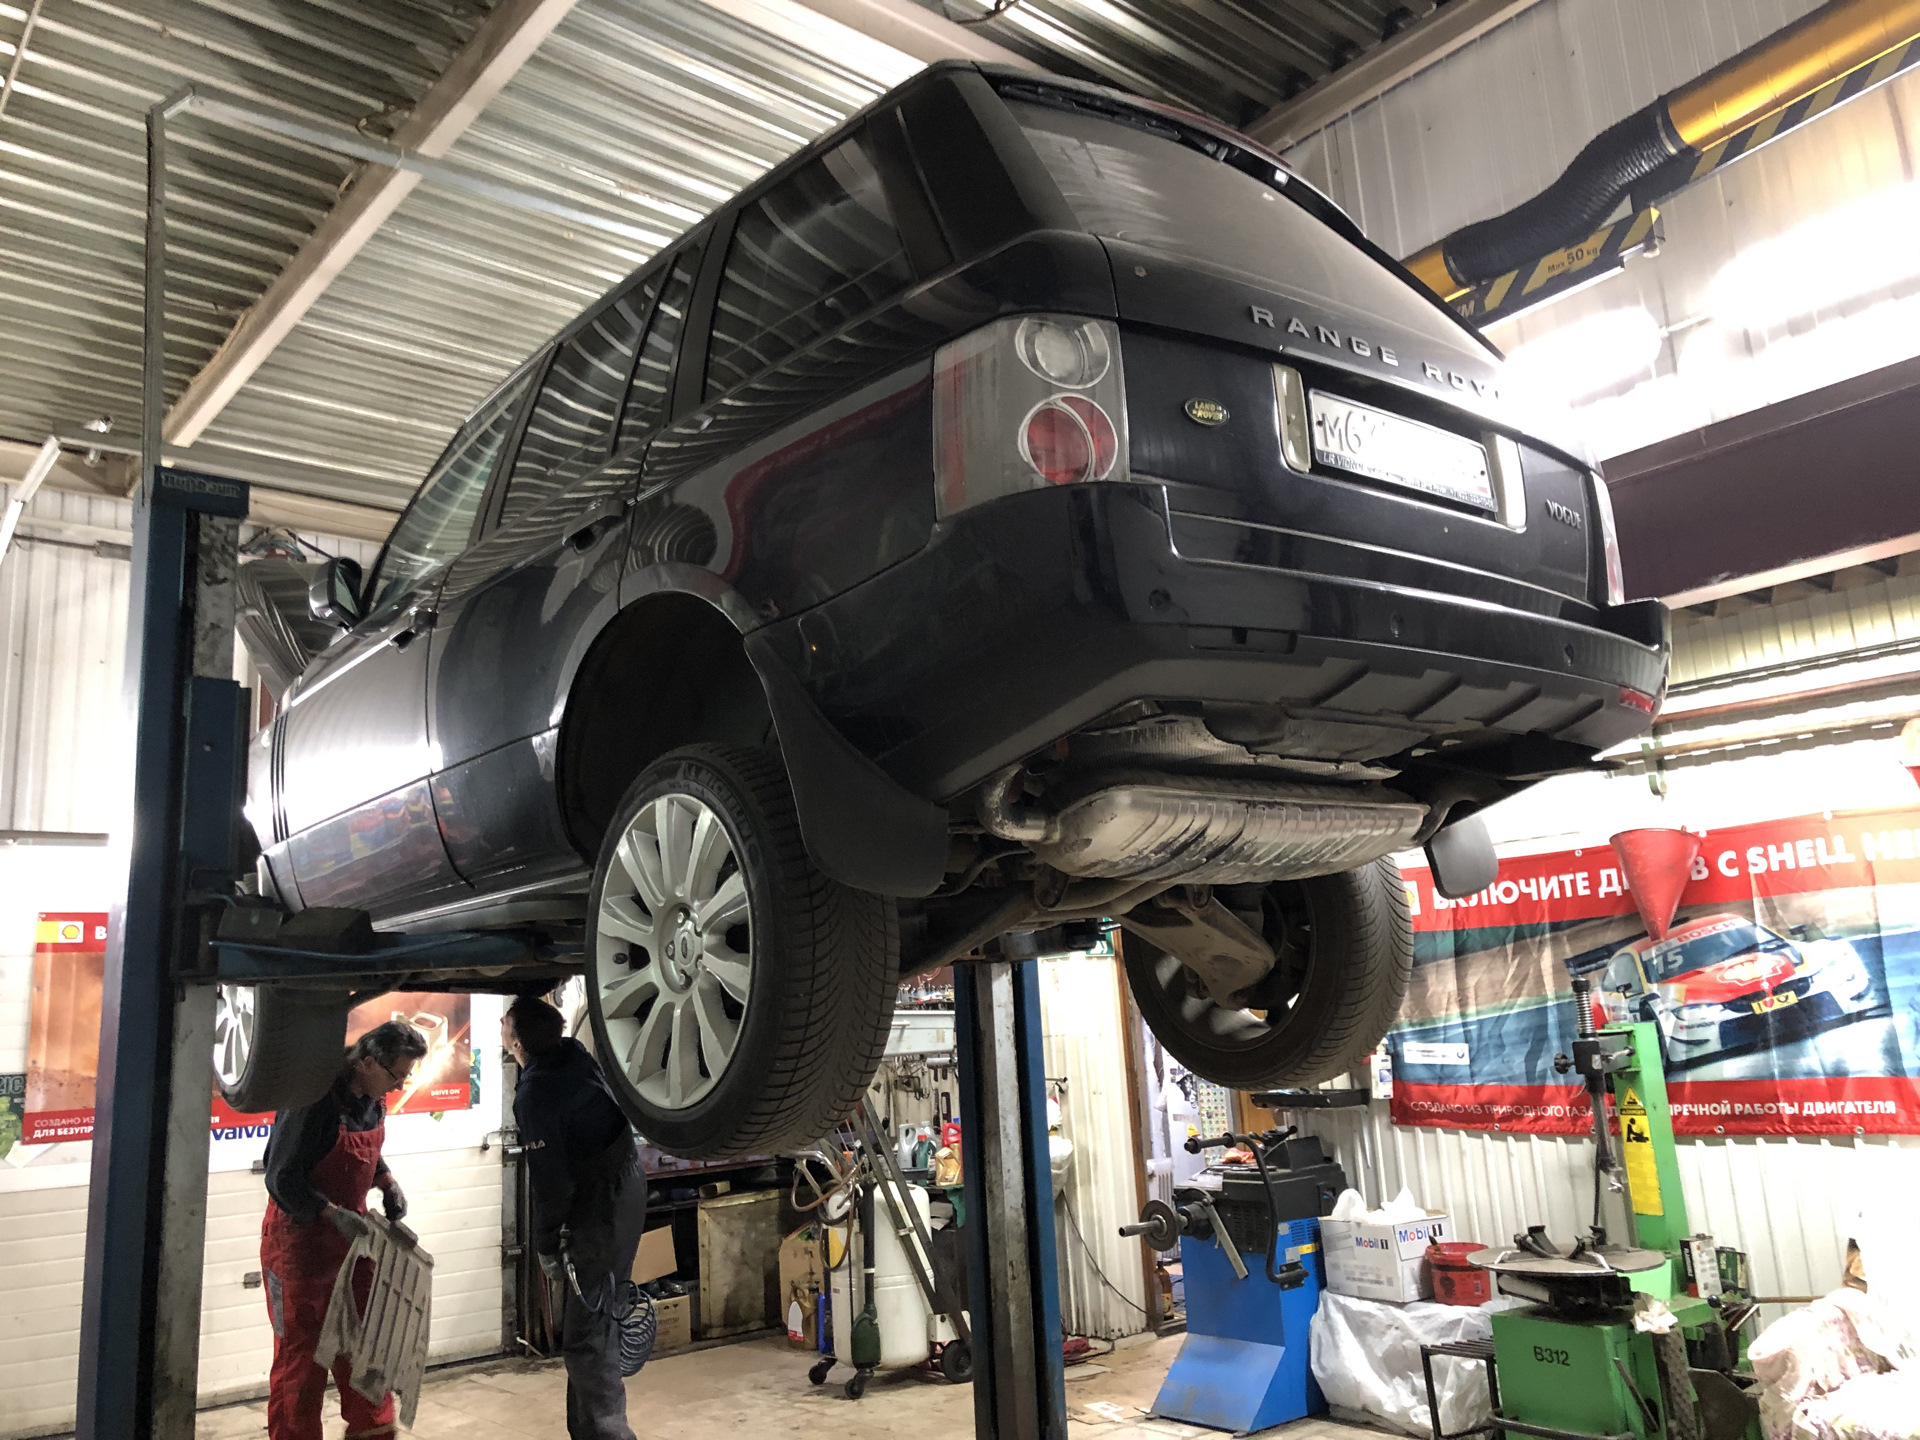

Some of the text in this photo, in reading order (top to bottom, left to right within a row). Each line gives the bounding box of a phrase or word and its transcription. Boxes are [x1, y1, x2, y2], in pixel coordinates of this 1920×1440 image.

[1567, 249, 1584, 266] 50
[1251, 305, 1499, 401] RANGE ROV
[1194, 401, 1216, 412] LAND
[1197, 409, 1223, 420] ROVER
[1545, 499, 1582, 530] VOGUE
[1746, 834, 1856, 875] SHELL
[1676, 922, 1736, 943] BOSCH
[430, 1088, 461, 1097] DRIVE ON
[1410, 1101, 1464, 1115] СОЗДАНО
[1466, 1104, 1483, 1115] ИЗ
[1485, 1103, 1565, 1118] ПРИРОДНОГО
[1566, 1105, 1594, 1118] ГАЗА
[1734, 1102, 1799, 1116] РАБОТЫ
[1802, 1101, 1896, 1117] ДВИГАТЕЛЯ
[34, 1117, 81, 1128] СОЗДАНО
[33, 1126, 94, 1139] ДЛЯ БЕЗУПР
[1398, 1224, 1443, 1243] Mobil 1
[1355, 1237, 1389, 1250] Mobil 1
[1533, 1345, 1571, 1367] B312
